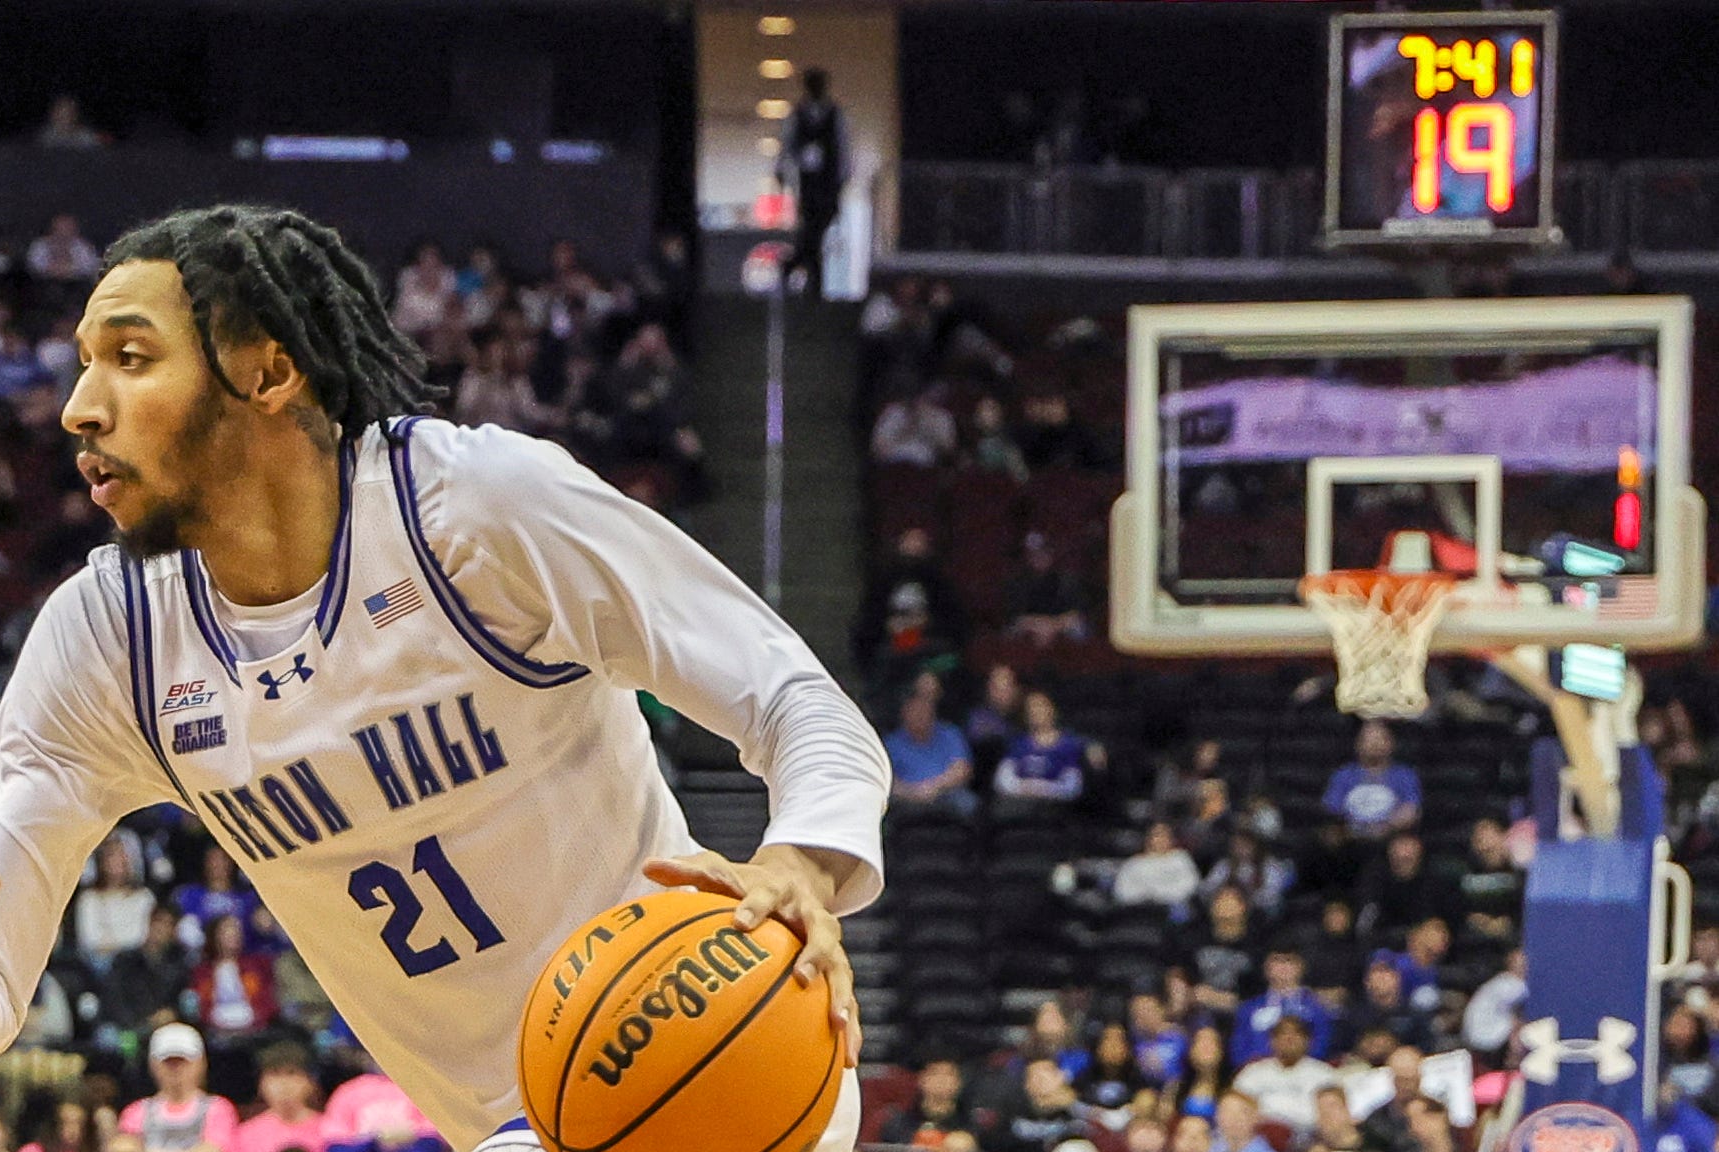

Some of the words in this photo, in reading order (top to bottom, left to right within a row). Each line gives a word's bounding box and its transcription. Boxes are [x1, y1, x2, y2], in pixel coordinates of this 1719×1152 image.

[1398, 34, 1536, 99] 7:41
[1411, 102, 1516, 213] 19
[162, 691, 218, 710] EAST
[167, 680, 206, 697] BIG
[174, 721, 192, 739] BE
[195, 715, 223, 736] THE
[172, 729, 228, 755] CHANGE
[350, 691, 509, 811] HALL
[348, 834, 507, 978] 21
[553, 902, 645, 1000] EVO
[588, 925, 772, 1087] Wilson
